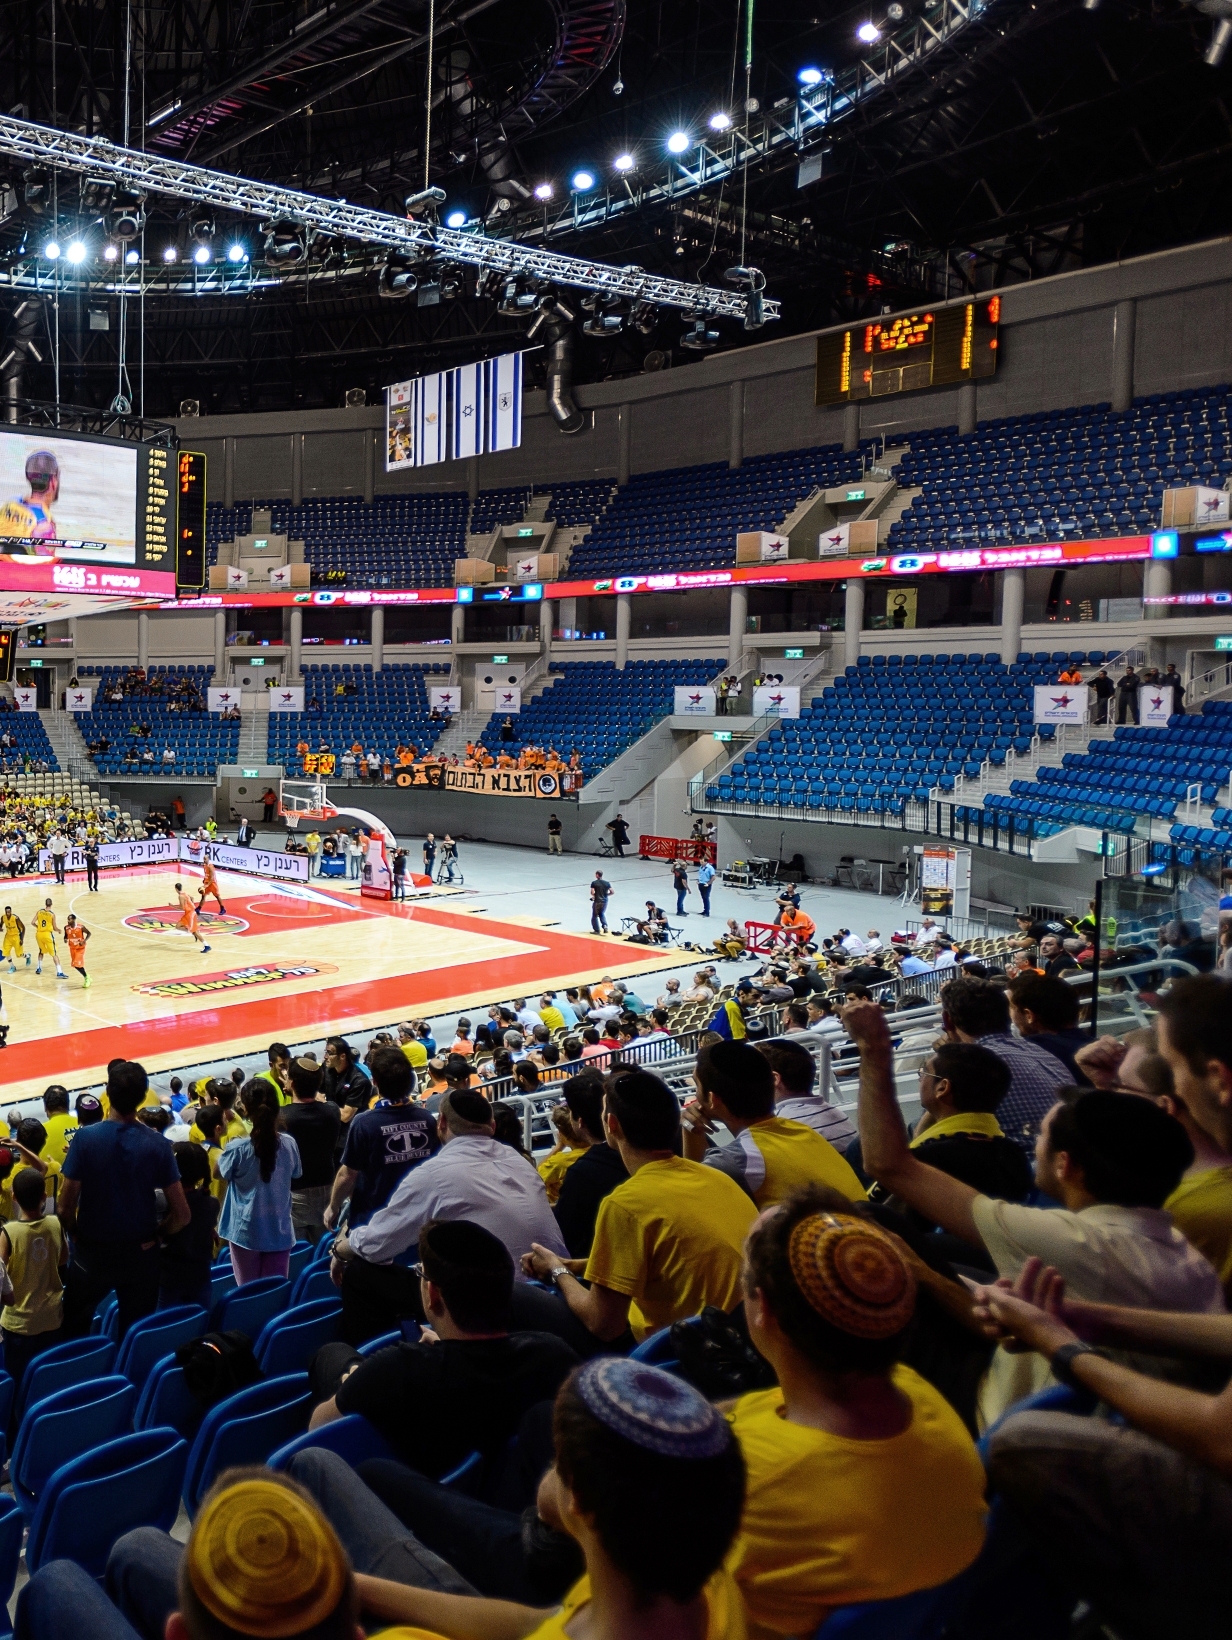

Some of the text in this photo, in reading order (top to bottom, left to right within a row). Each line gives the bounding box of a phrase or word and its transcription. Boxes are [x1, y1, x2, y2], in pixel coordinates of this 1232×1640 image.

[446, 771, 532, 793] הצבא הכתום
[129, 842, 172, 861] רענן כץ
[221, 855, 248, 868] CENTERS
[256, 854, 300, 873] רענן כץ
[150, 971, 285, 996] Winner
[400, 1122, 427, 1131] COUNTY
[32, 1237, 48, 1262] 8
